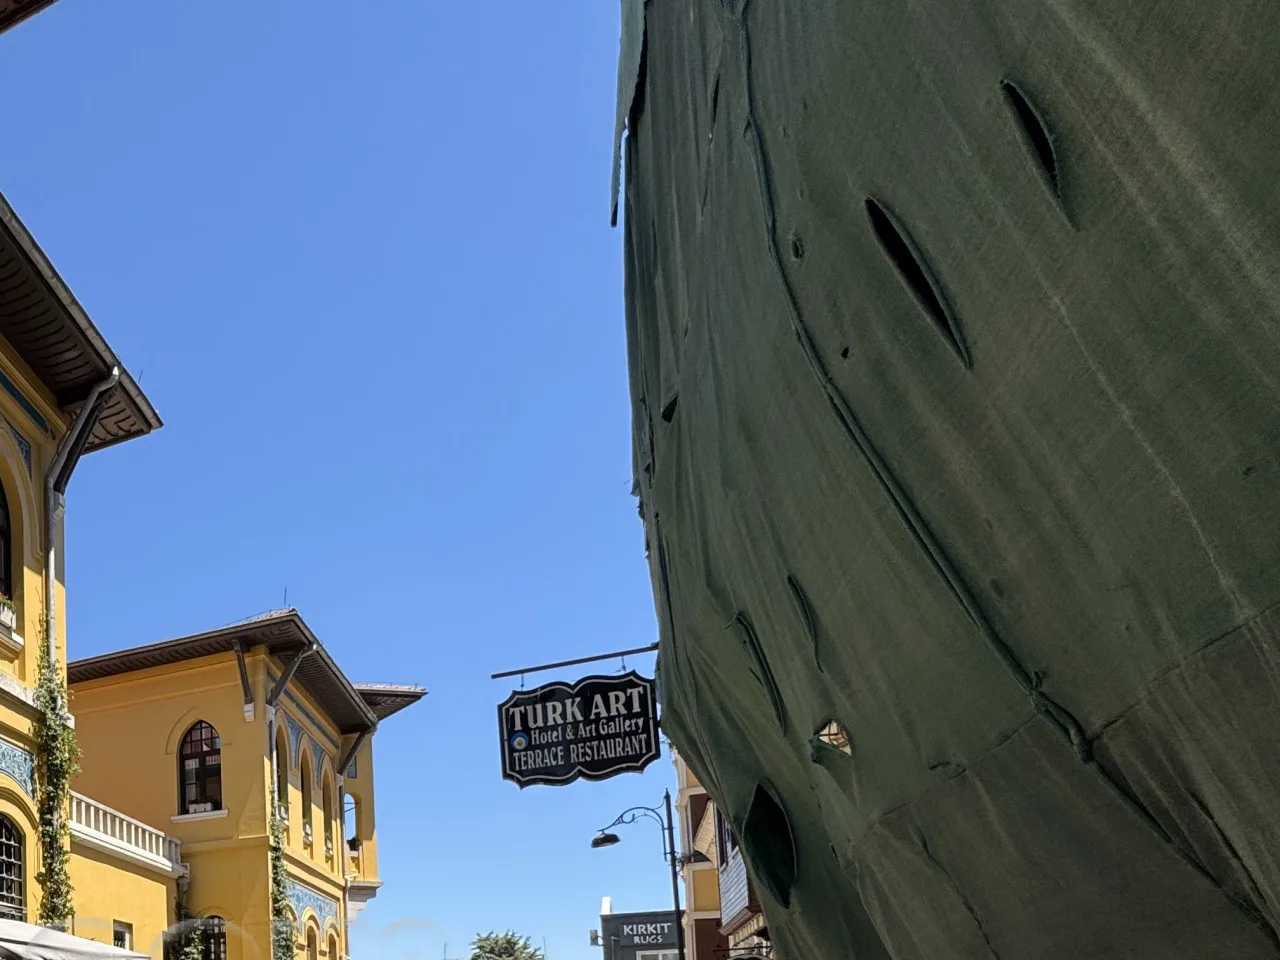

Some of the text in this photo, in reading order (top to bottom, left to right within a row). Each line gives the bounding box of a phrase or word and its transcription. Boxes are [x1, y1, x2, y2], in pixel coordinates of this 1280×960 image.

[508, 687, 644, 731] TURK ART
[531, 717, 644, 745] Hotel & Art Gallery
[513, 734, 647, 771] TERRACE RESTAURANT
[623, 923, 672, 935] KIRKIT
[633, 935, 662, 944] RUGS
